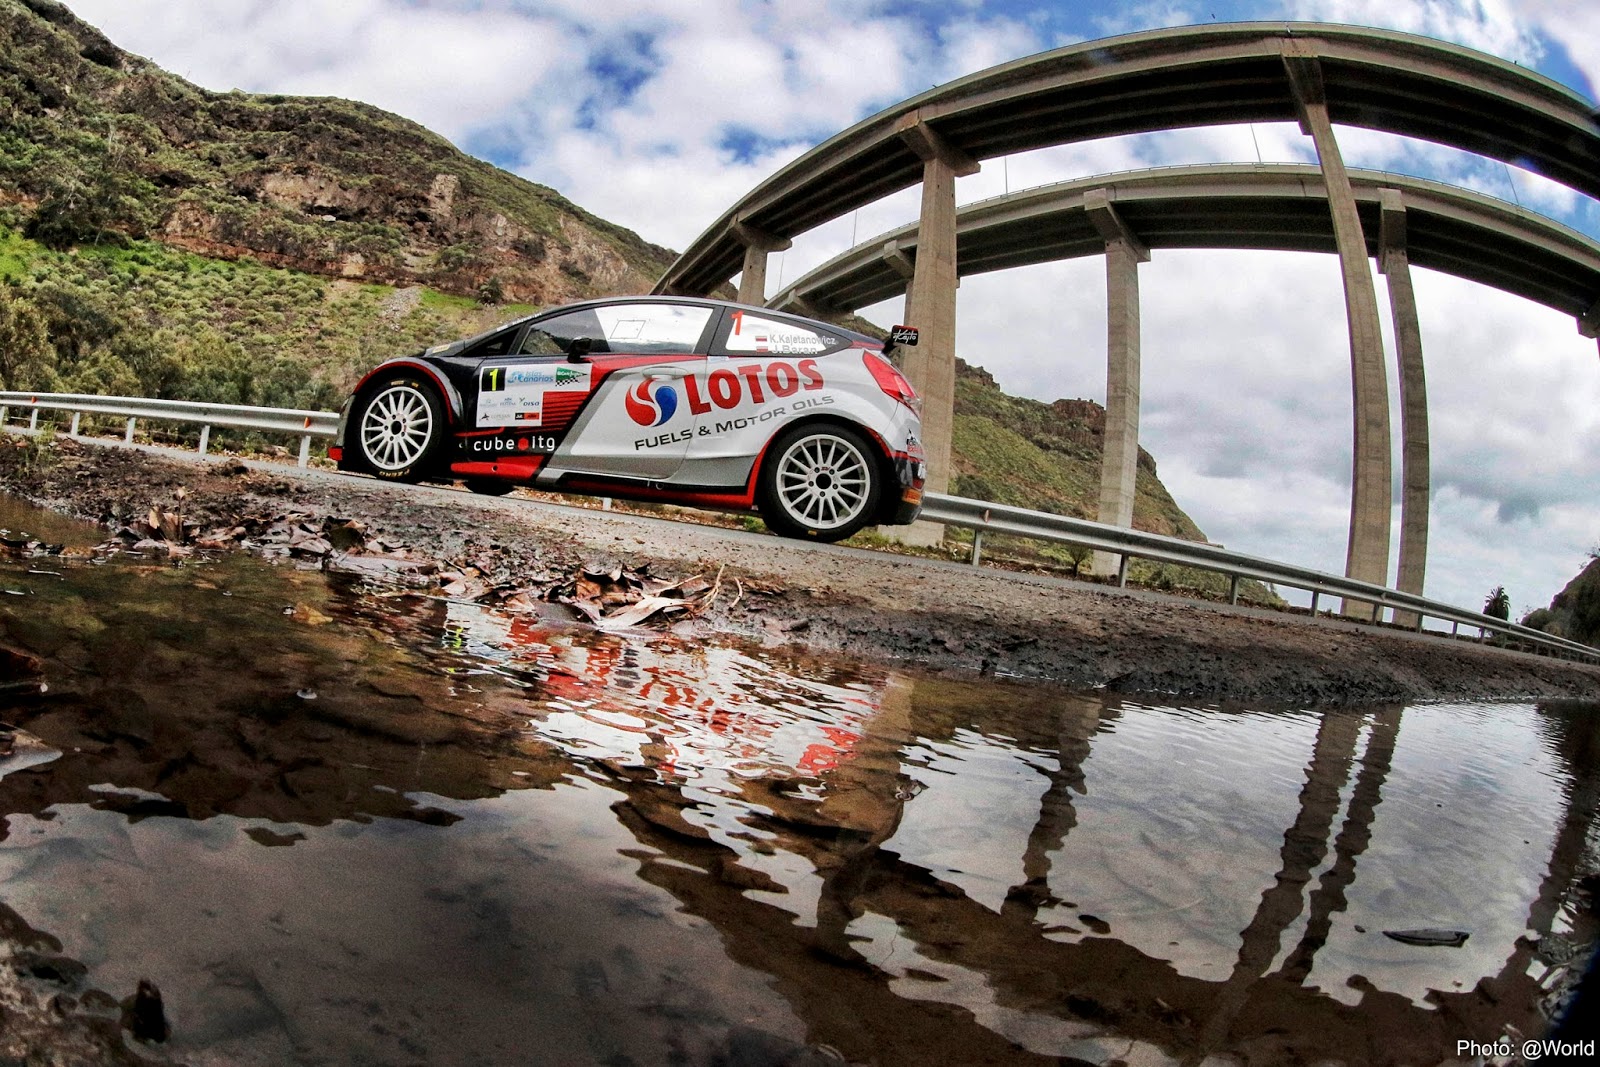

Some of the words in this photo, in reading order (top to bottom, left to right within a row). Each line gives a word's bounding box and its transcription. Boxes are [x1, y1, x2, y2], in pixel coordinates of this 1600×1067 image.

[731, 311, 744, 335] 1
[490, 368, 499, 391] 1
[684, 359, 825, 416] LOTOS
[634, 428, 693, 450] FUELS
[698, 425, 711, 436] &
[716, 406, 787, 433] MOTOR
[792, 395, 835, 412] OILS
[473, 436, 515, 451] cube
[531, 435, 556, 451] itg
